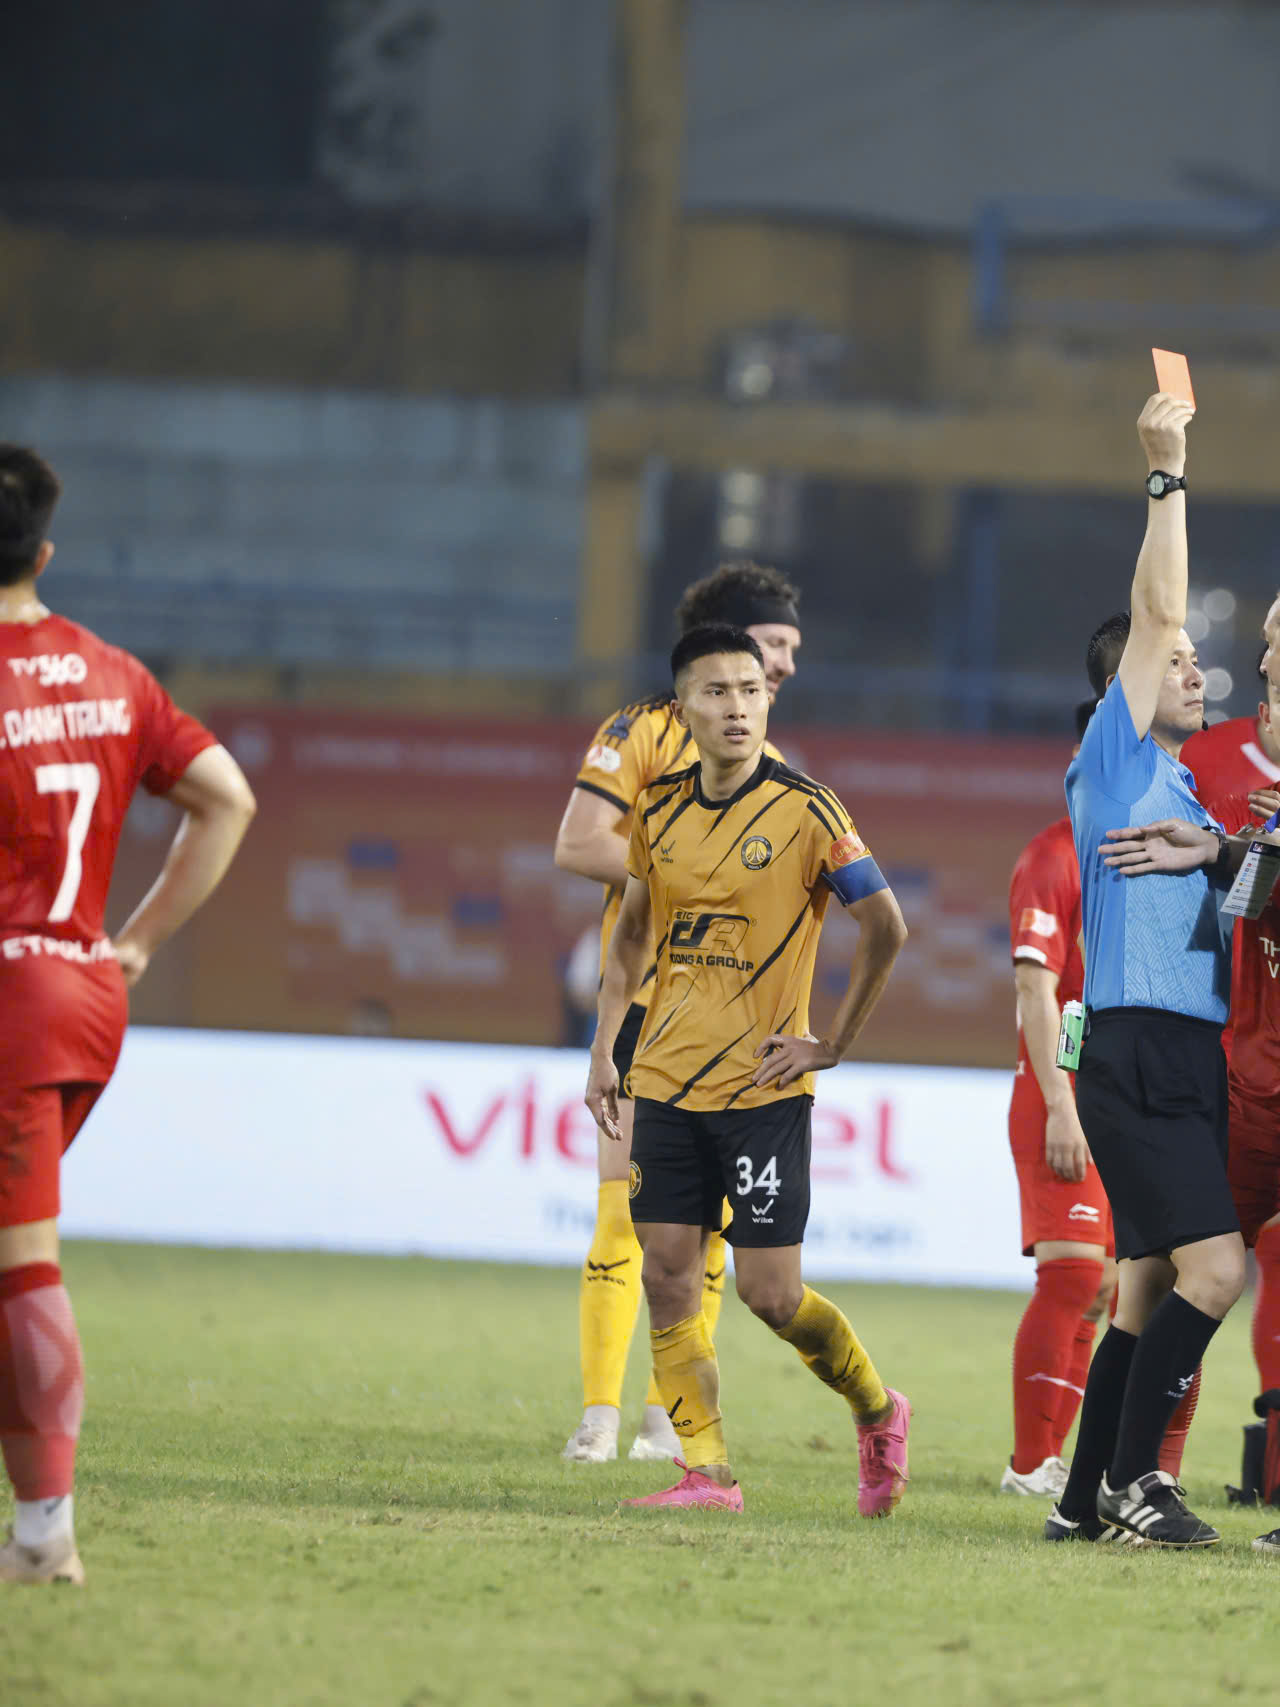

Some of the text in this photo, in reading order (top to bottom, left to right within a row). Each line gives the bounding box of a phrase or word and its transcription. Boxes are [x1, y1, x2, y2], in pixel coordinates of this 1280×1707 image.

[4, 697, 131, 748] DANH TRUNG
[35, 762, 102, 923] 7
[696, 955, 705, 966] A
[706, 955, 754, 972] GROUP
[736, 1156, 782, 1196] 34
